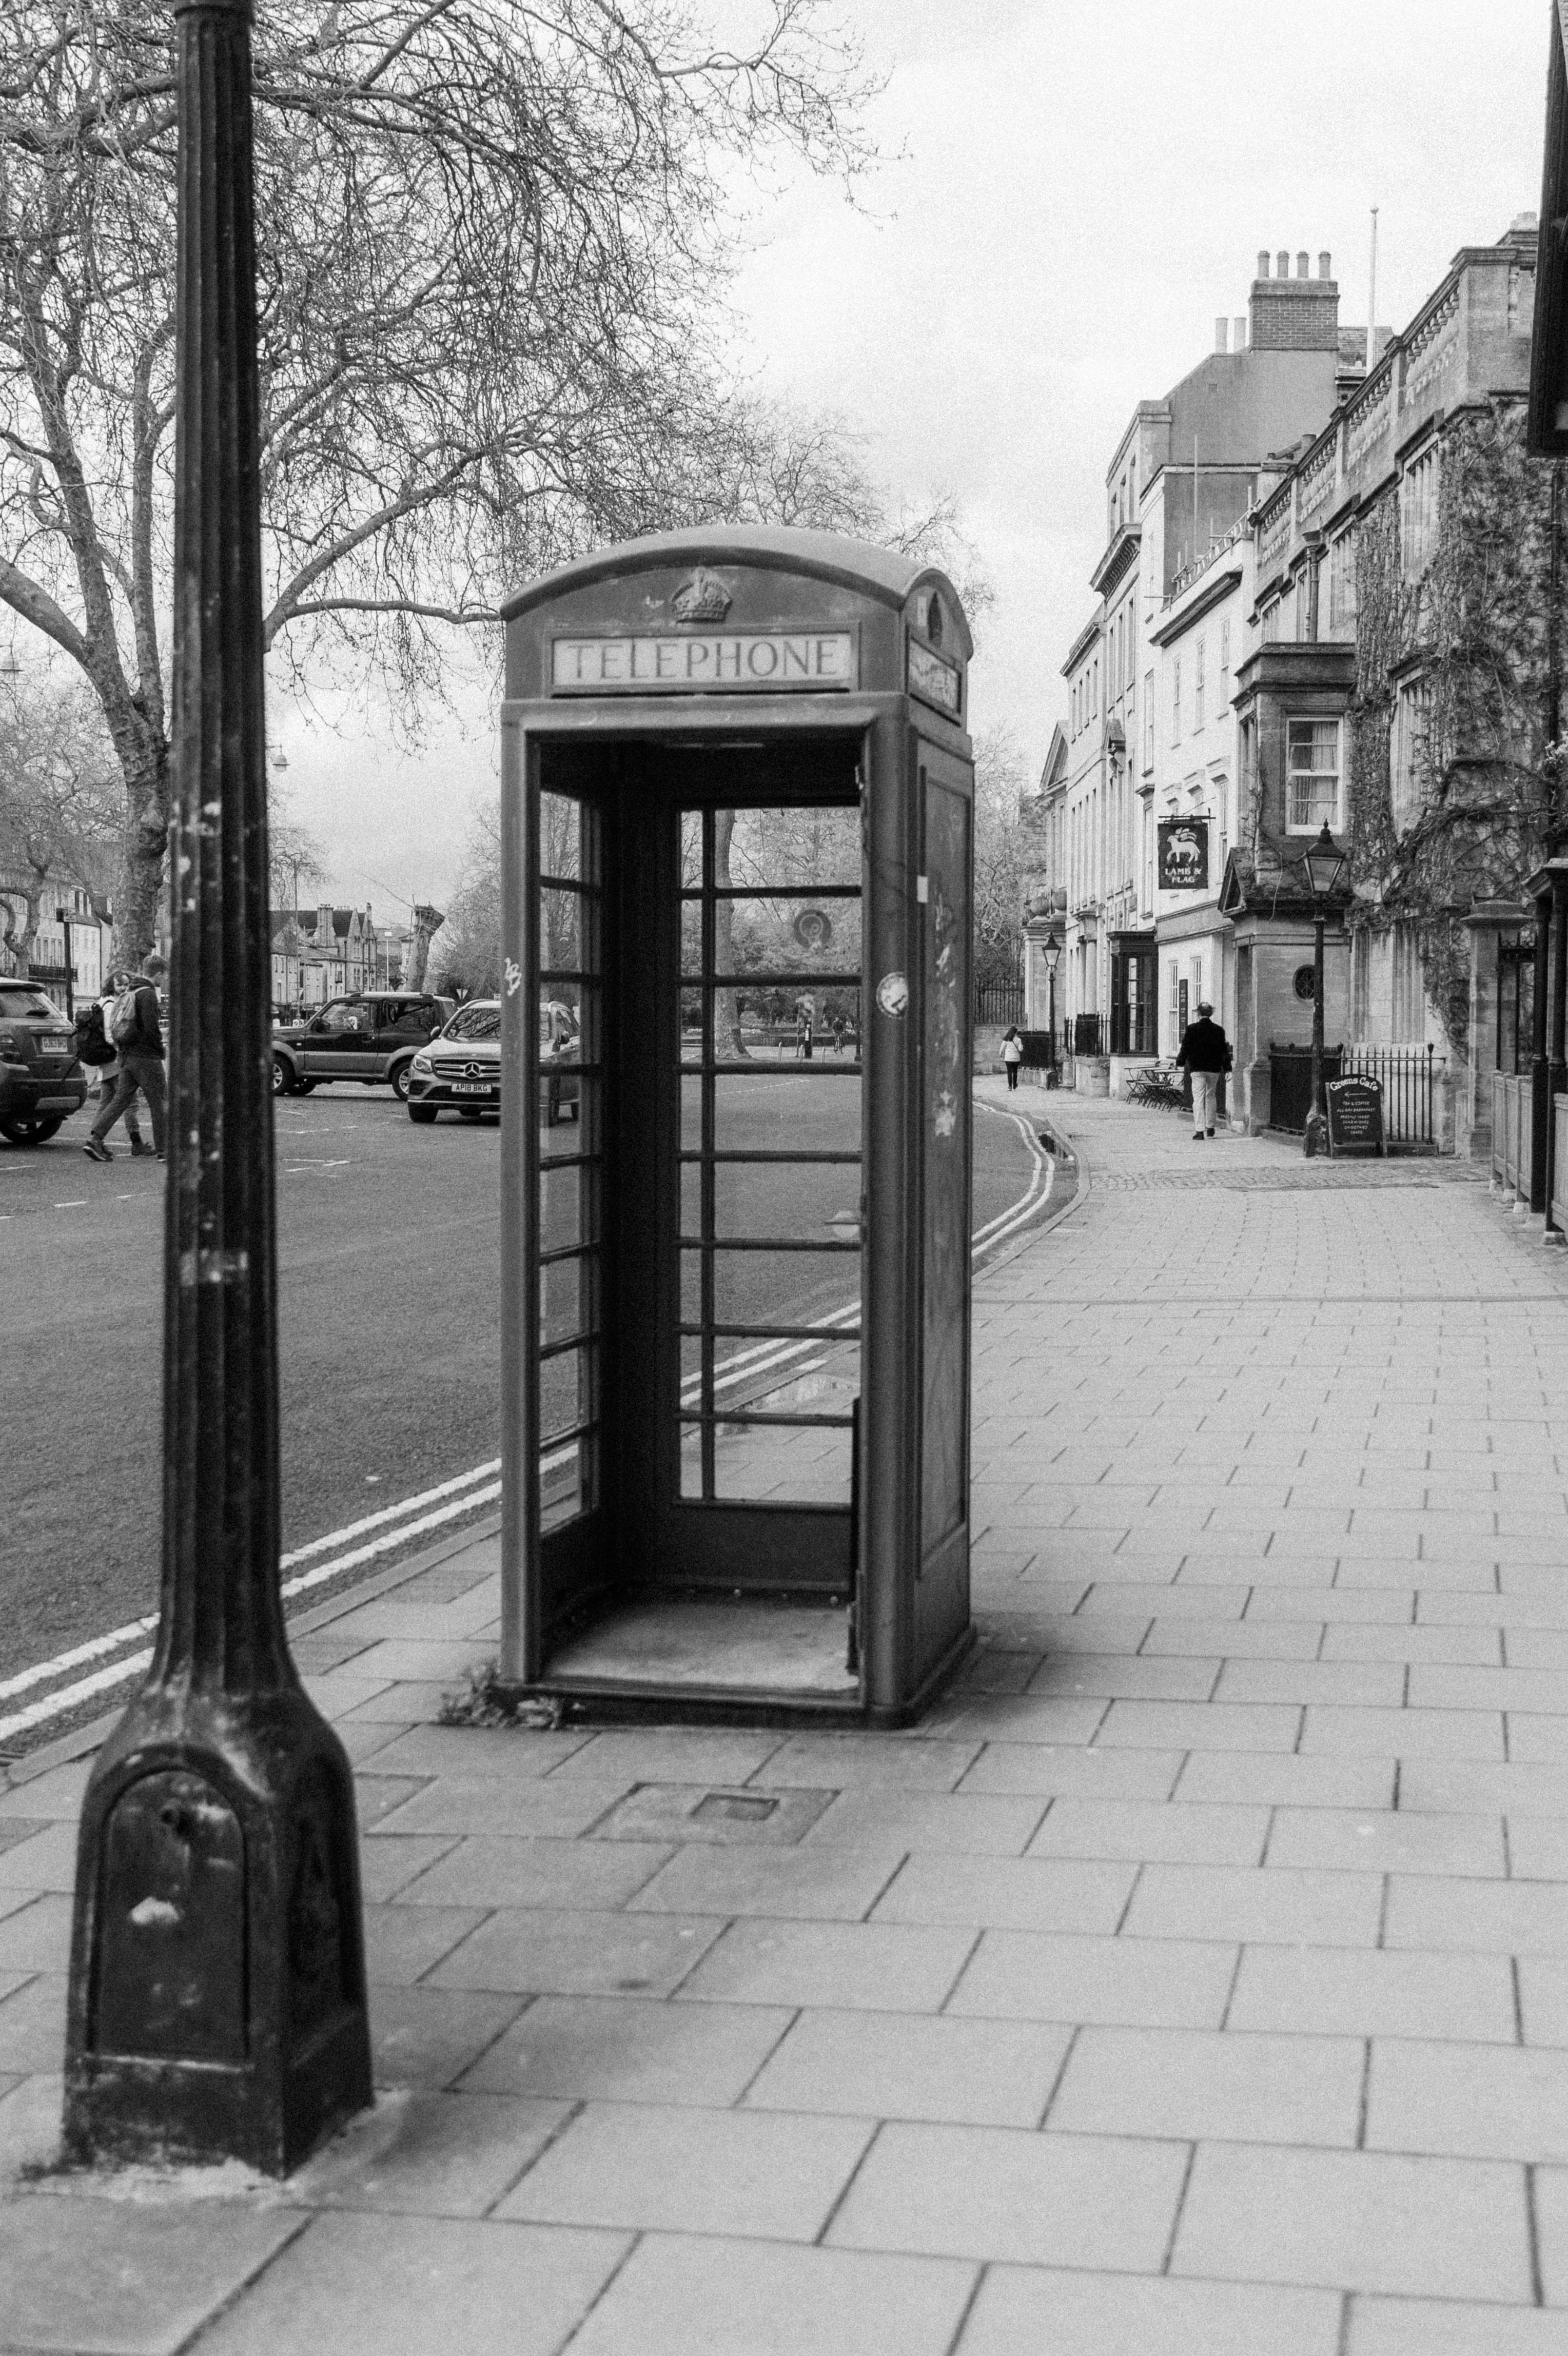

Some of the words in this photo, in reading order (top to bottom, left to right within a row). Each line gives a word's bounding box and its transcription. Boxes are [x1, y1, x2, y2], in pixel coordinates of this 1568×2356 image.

[567, 640, 839, 678] TELEPHONE
[1330, 1078, 1358, 1091] Greens
[1360, 1077, 1378, 1091] Cafe
